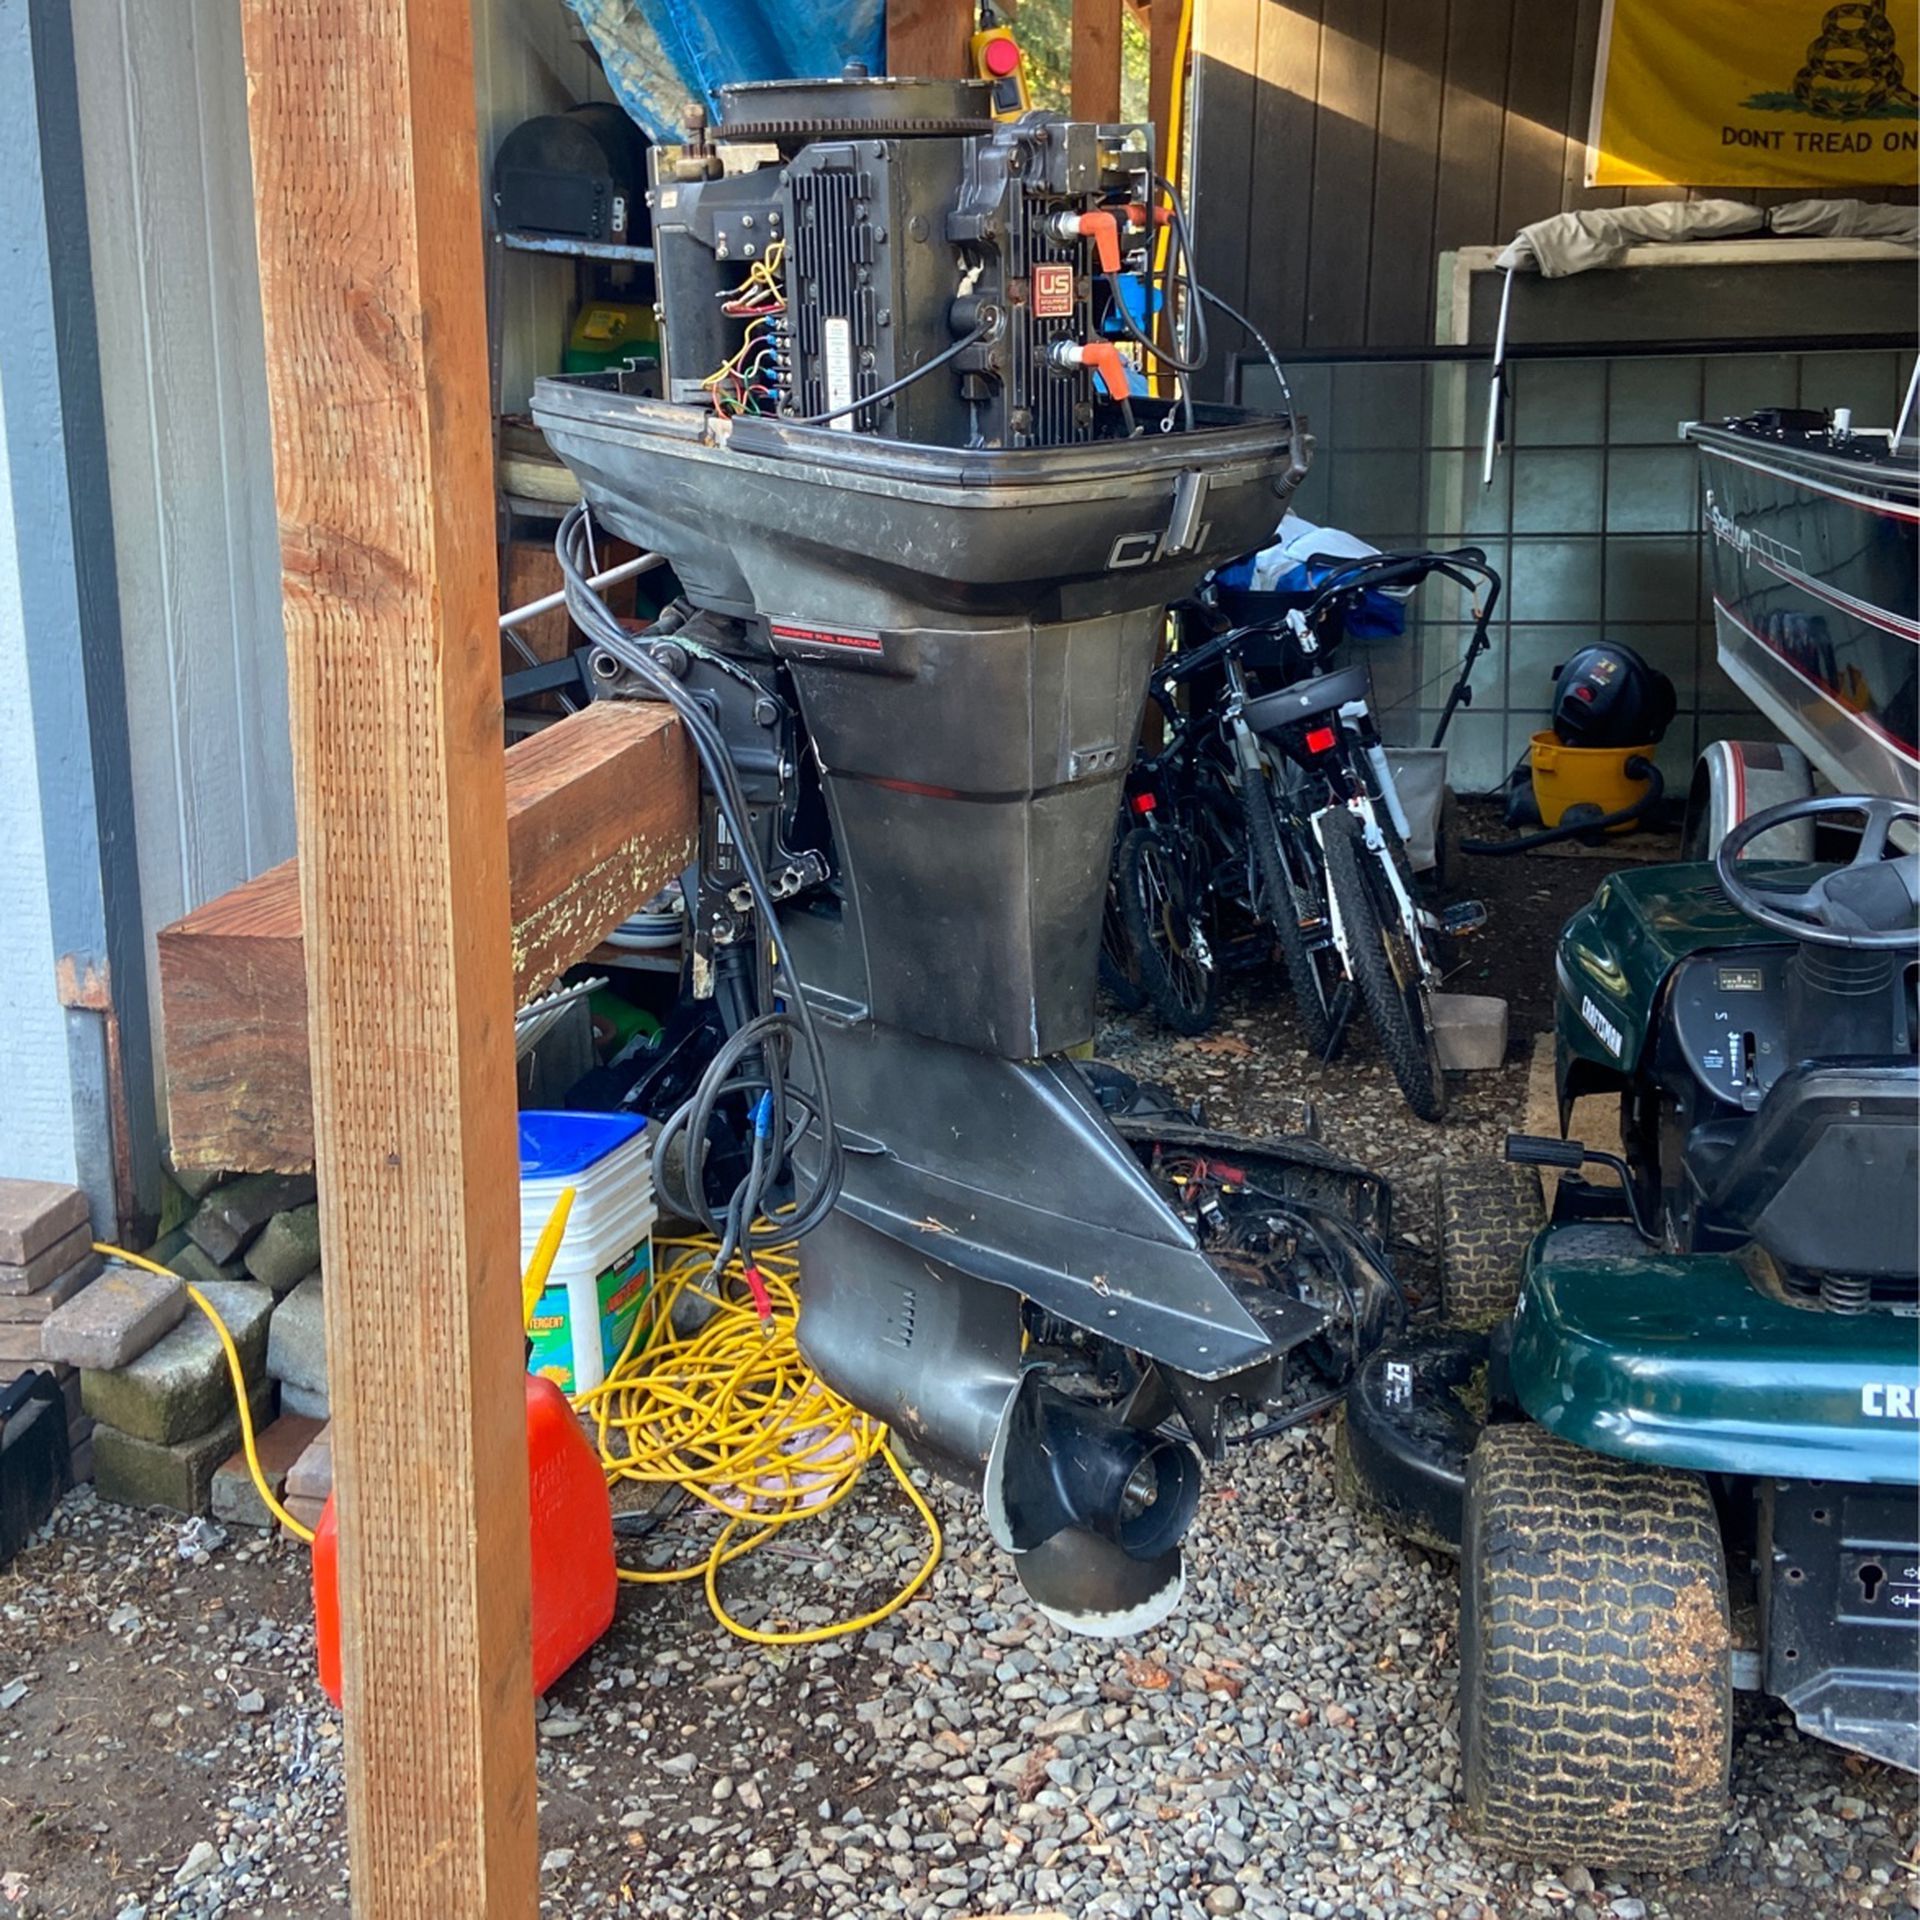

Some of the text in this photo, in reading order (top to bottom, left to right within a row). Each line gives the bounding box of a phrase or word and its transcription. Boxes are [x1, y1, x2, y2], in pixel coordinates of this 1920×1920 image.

[1721, 126, 1919, 153] DONT TREAD ON
[1040, 274, 1070, 294] US
[1387, 1361, 1410, 1381] EZ
[1861, 1383, 1919, 1418] CR
